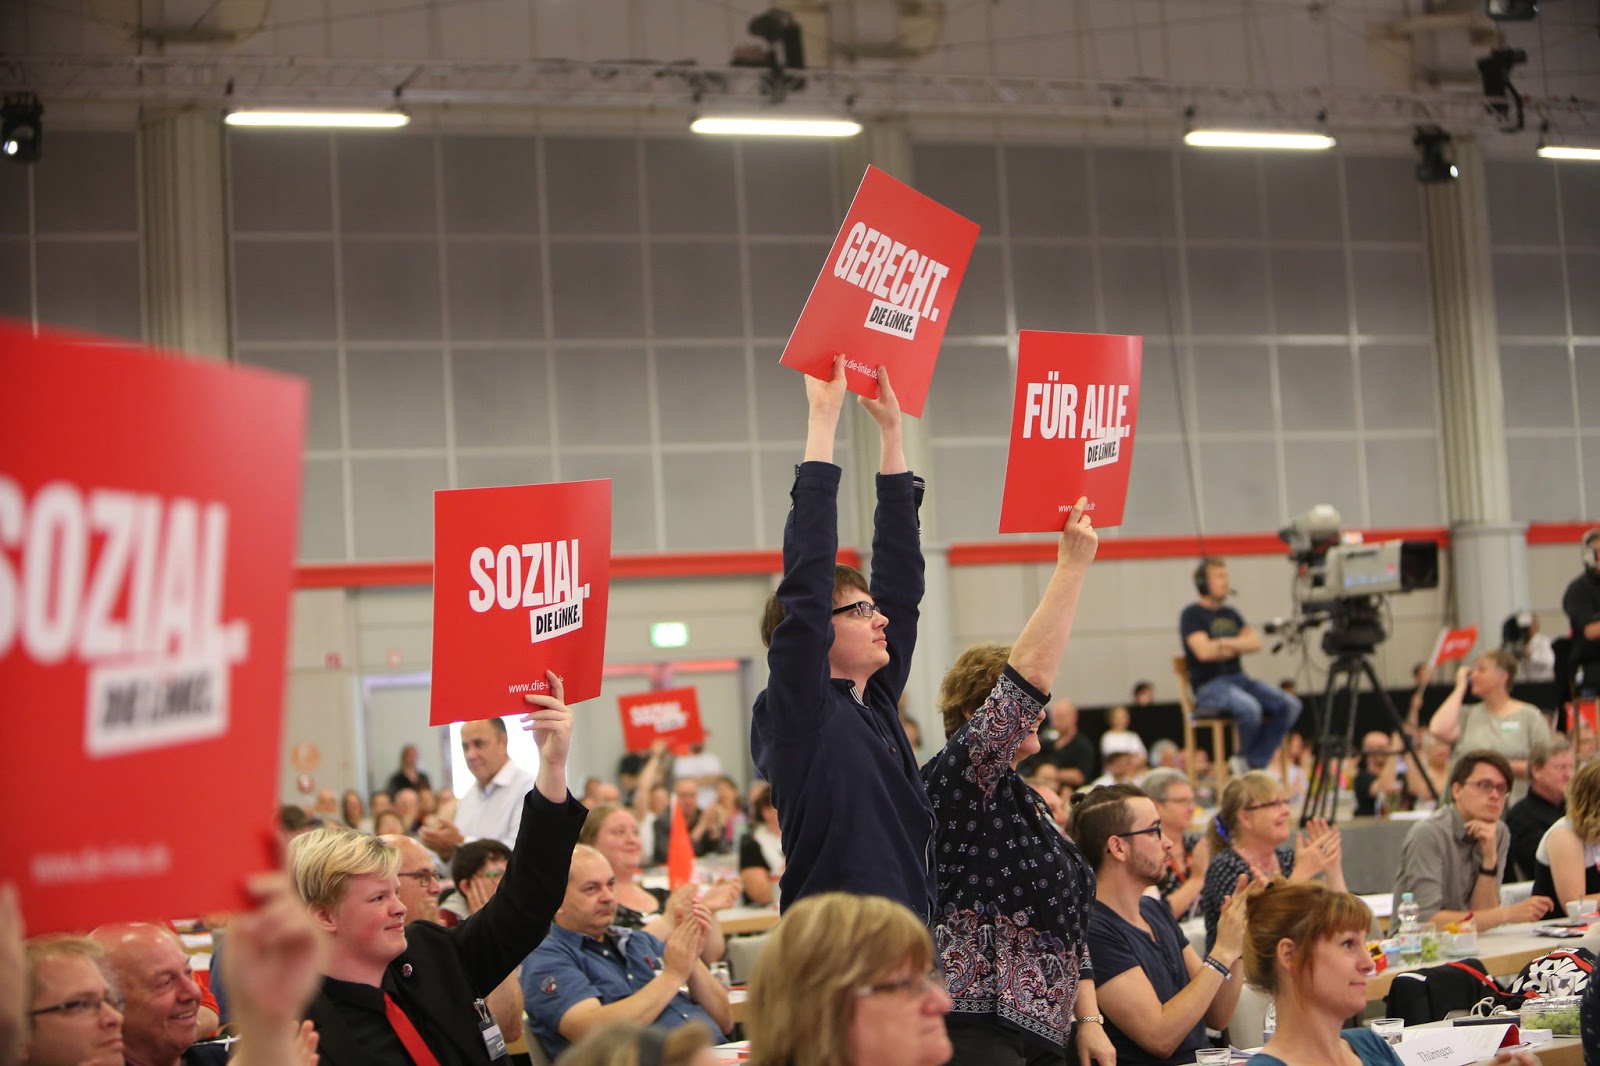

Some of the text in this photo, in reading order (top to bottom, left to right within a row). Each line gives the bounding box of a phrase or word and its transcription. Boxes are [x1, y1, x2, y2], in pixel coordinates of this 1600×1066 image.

[833, 221, 950, 322] GERECHT.
[869, 305, 888, 325] DIE
[1022, 371, 1131, 439] FÜR ALLE.
[1087, 444, 1099, 464] DIE
[469, 538, 591, 613] SOZIAL.
[536, 612, 553, 635] DIE
[1416, 1045, 1454, 1063] Thüringen
